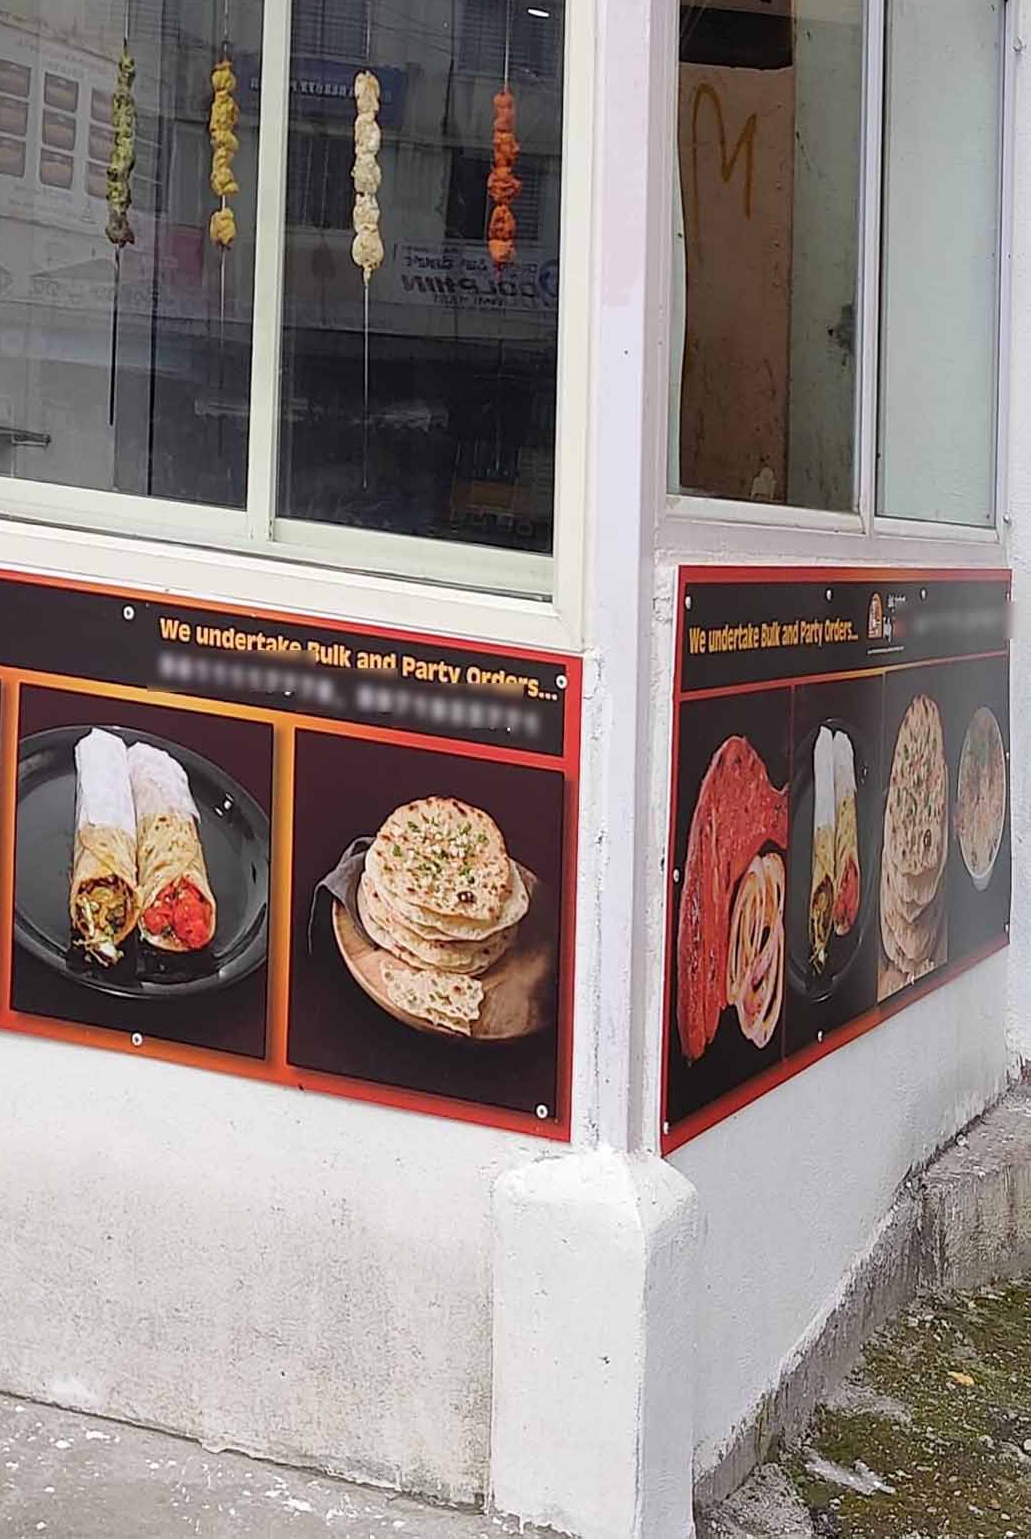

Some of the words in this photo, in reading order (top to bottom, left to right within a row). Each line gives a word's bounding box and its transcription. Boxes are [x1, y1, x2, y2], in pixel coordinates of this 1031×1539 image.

[159, 617, 191, 641] We
[196, 625, 302, 651] undertake
[356, 651, 396, 669] and
[402, 655, 460, 684] Party
[689, 626, 706, 654] We
[708, 623, 760, 653] undertake
[761, 621, 780, 648] Bulk
[782, 620, 799, 645] and
[800, 619, 823, 646] Party
